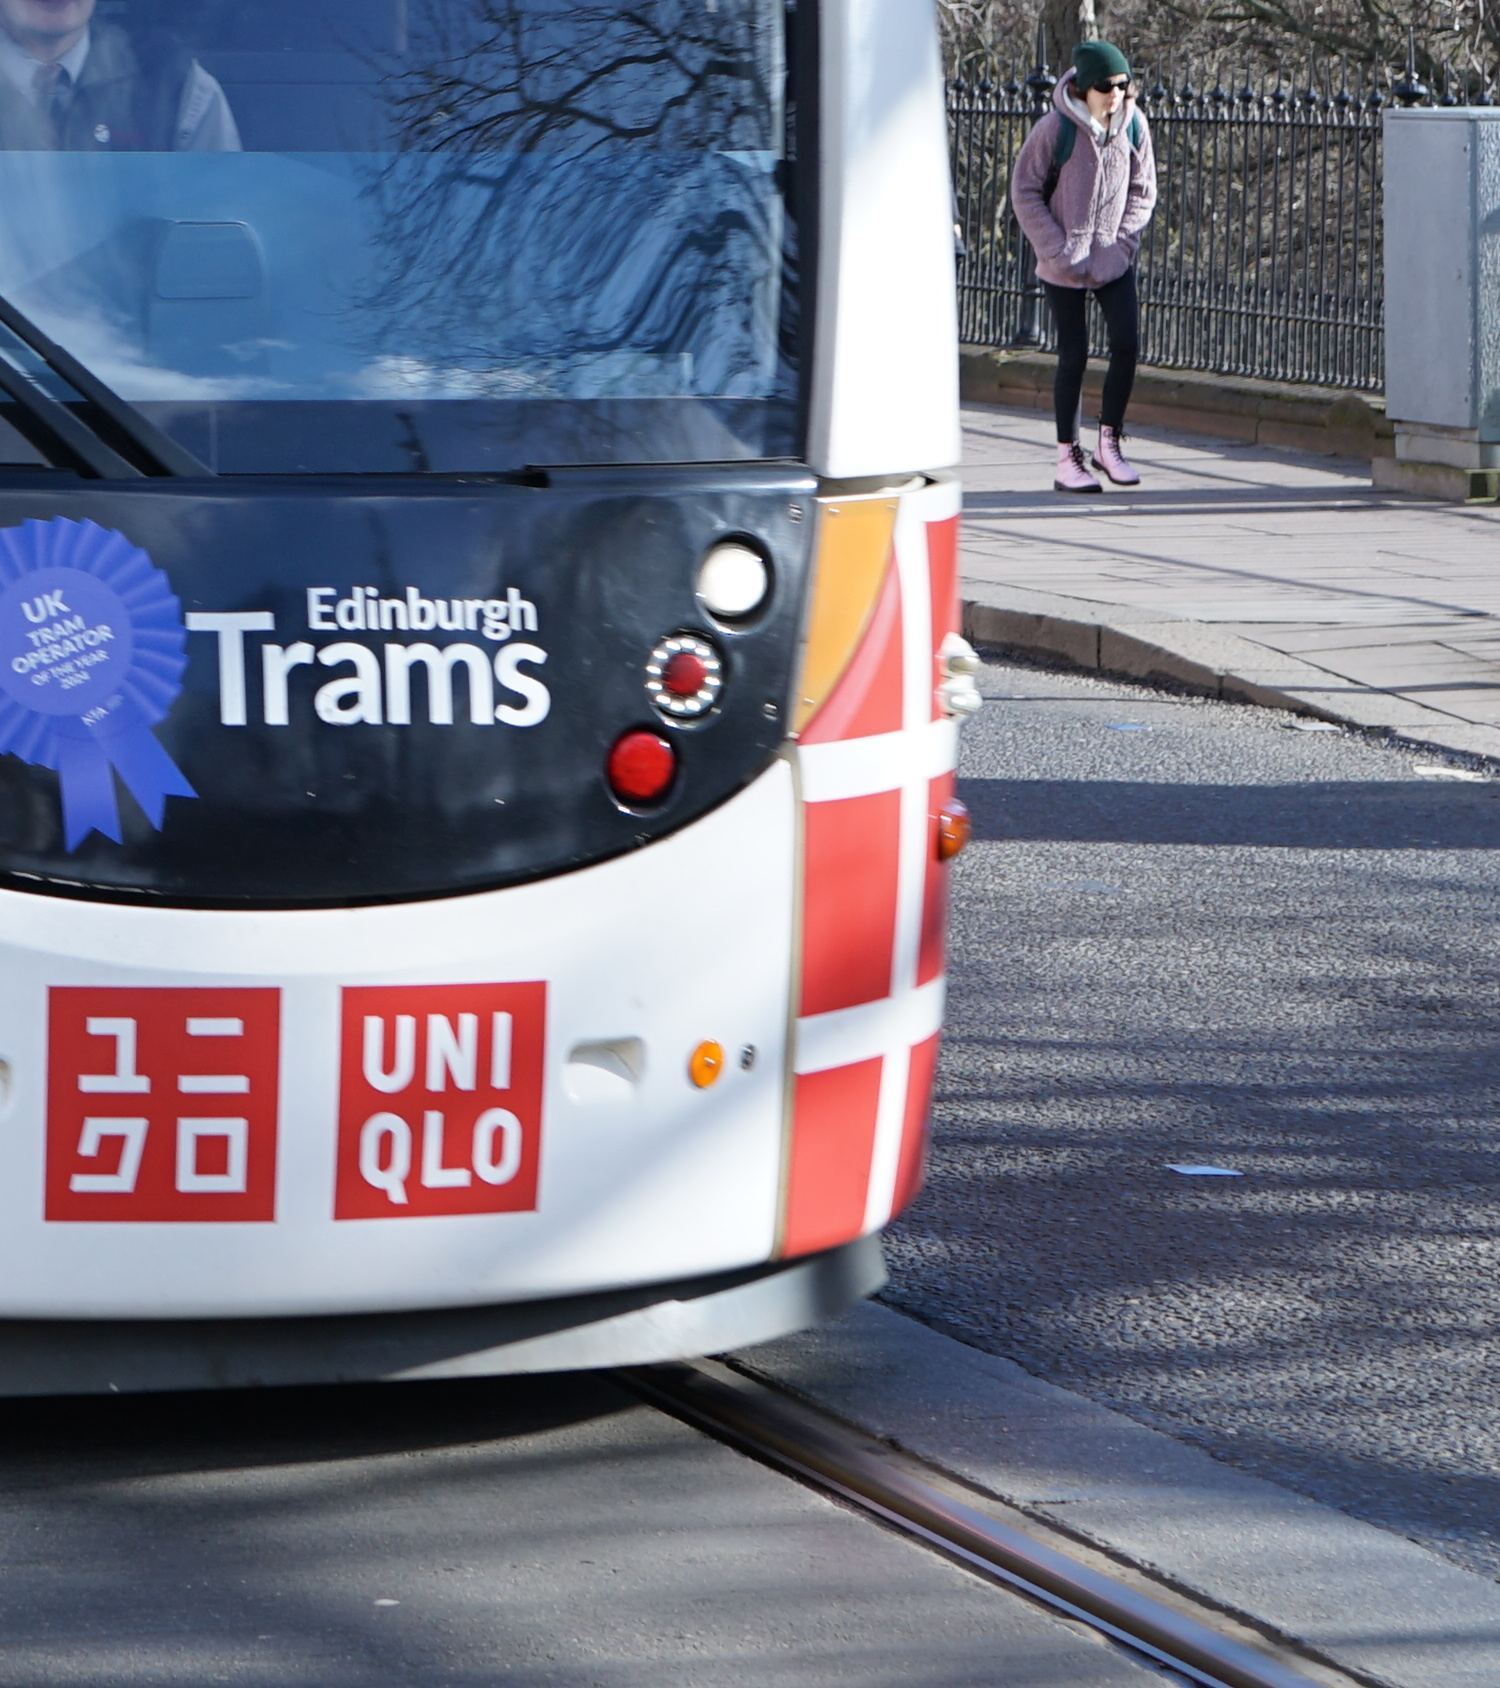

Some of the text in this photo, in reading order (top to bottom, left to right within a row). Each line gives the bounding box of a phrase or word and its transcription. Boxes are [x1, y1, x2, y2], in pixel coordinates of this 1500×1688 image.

[20, 589, 71, 623] UK
[26, 615, 86, 647] TRAM
[307, 587, 537, 640] Edinburgh
[11, 624, 116, 673] OPERATOR
[72, 649, 110, 669] YEAR
[186, 611, 550, 728] Trams
[78, 1016, 251, 1095] ユニ
[363, 1011, 514, 1095] UNI
[70, 1116, 249, 1194] クロ
[359, 1106, 522, 1204] QLO
